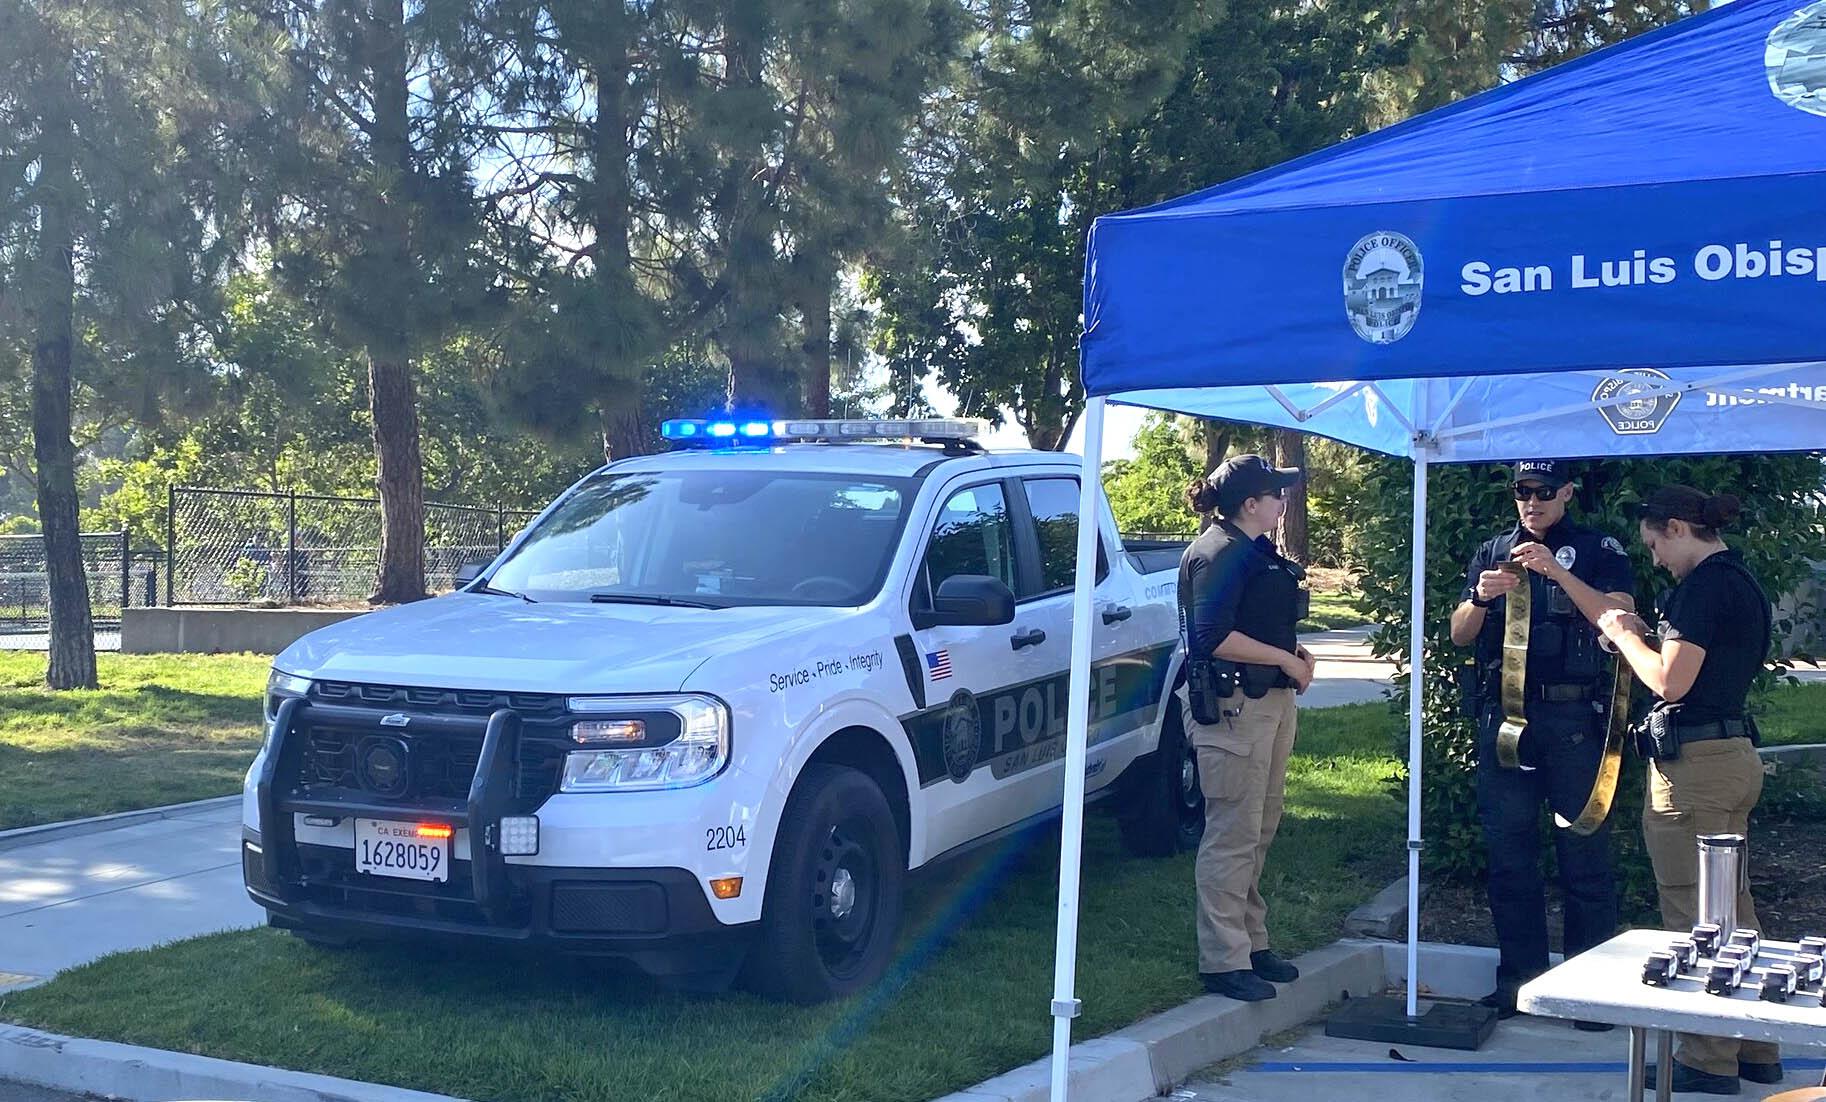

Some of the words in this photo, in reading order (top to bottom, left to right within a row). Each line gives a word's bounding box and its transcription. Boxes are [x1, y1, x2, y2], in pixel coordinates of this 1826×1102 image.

[1348, 238, 1379, 272] POLICE
[1461, 261, 1552, 296] San
[1571, 249, 1676, 288] Luis
[1520, 461, 1552, 472] POLICE
[769, 667, 810, 692] Service
[817, 660, 843, 679] Pride
[849, 649, 883, 672] Integrity
[994, 664, 1117, 753] POLE
[378, 827, 389, 835] CA
[393, 828, 421, 838] EXEMP
[706, 824, 746, 851] 2204
[362, 839, 440, 873] 1628059
